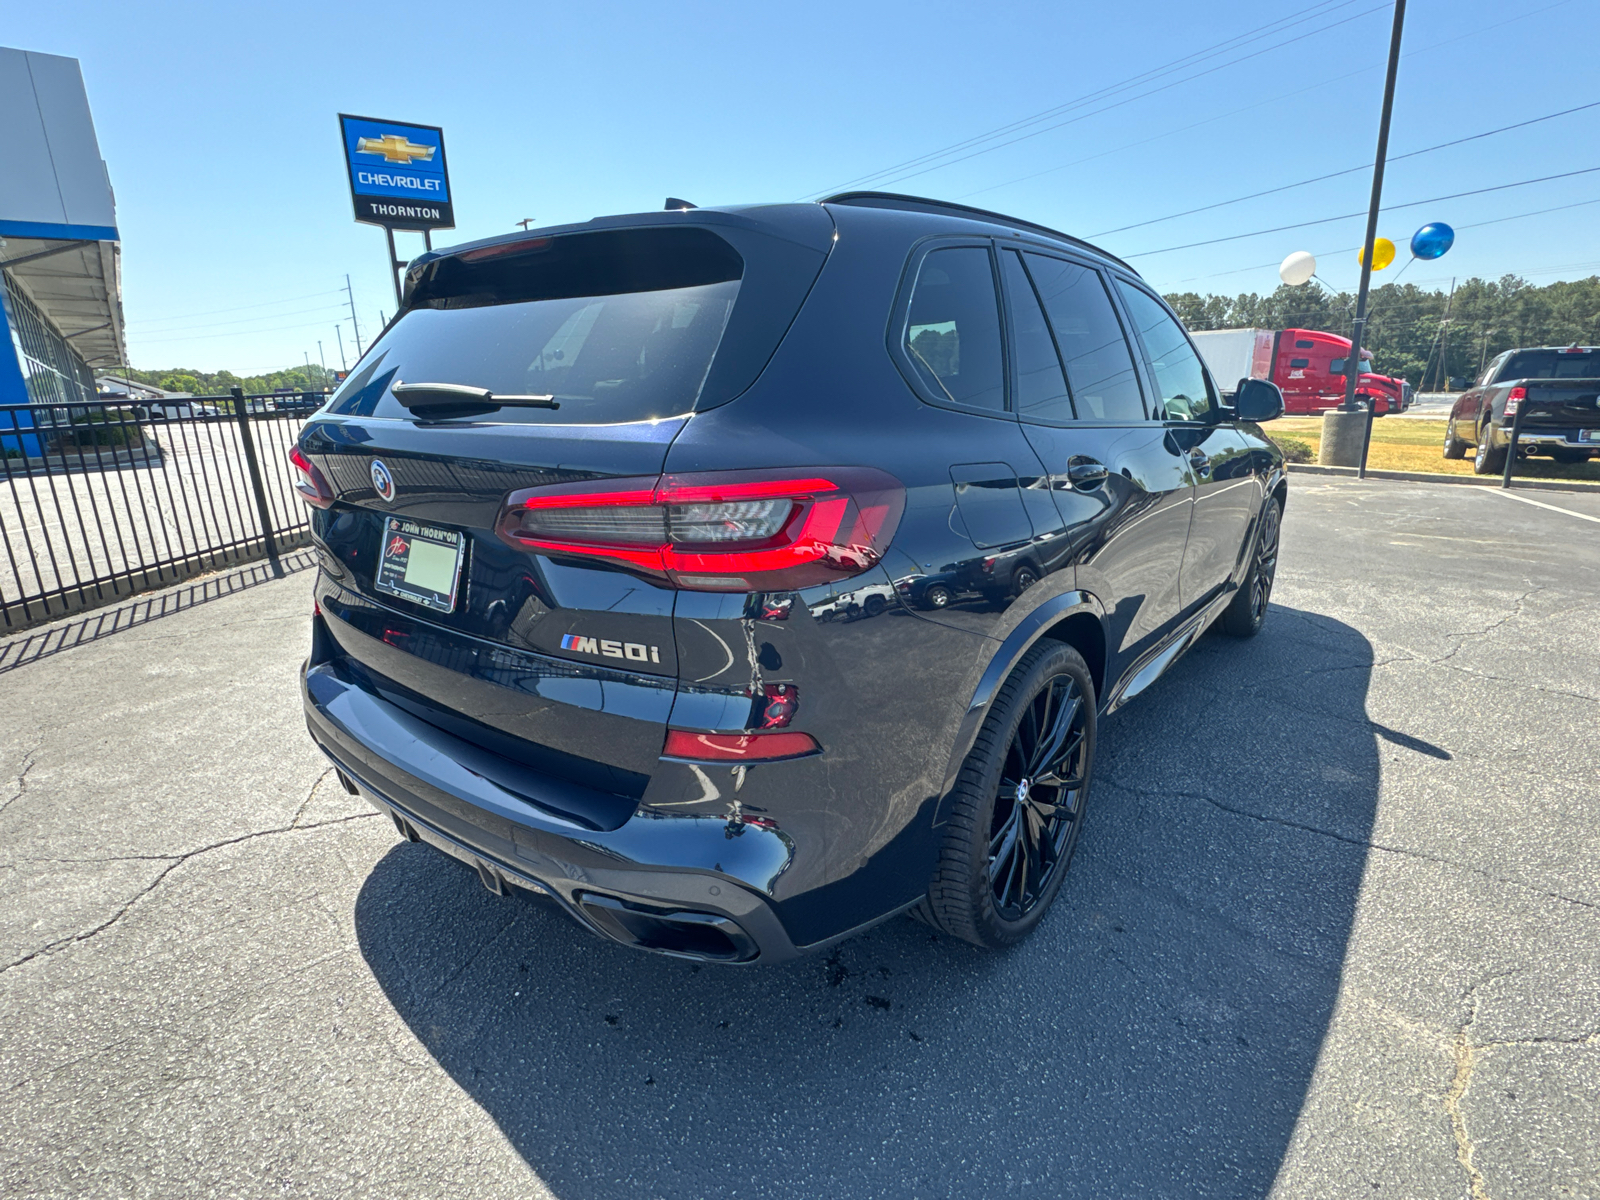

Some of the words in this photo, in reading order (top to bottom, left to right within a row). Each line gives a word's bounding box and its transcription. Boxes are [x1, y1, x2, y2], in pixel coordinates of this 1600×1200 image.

[358, 172, 441, 191] CHEVROLET
[370, 203, 440, 219] THORNTON
[401, 522, 420, 535] JOHN
[576, 635, 660, 664] M50i
